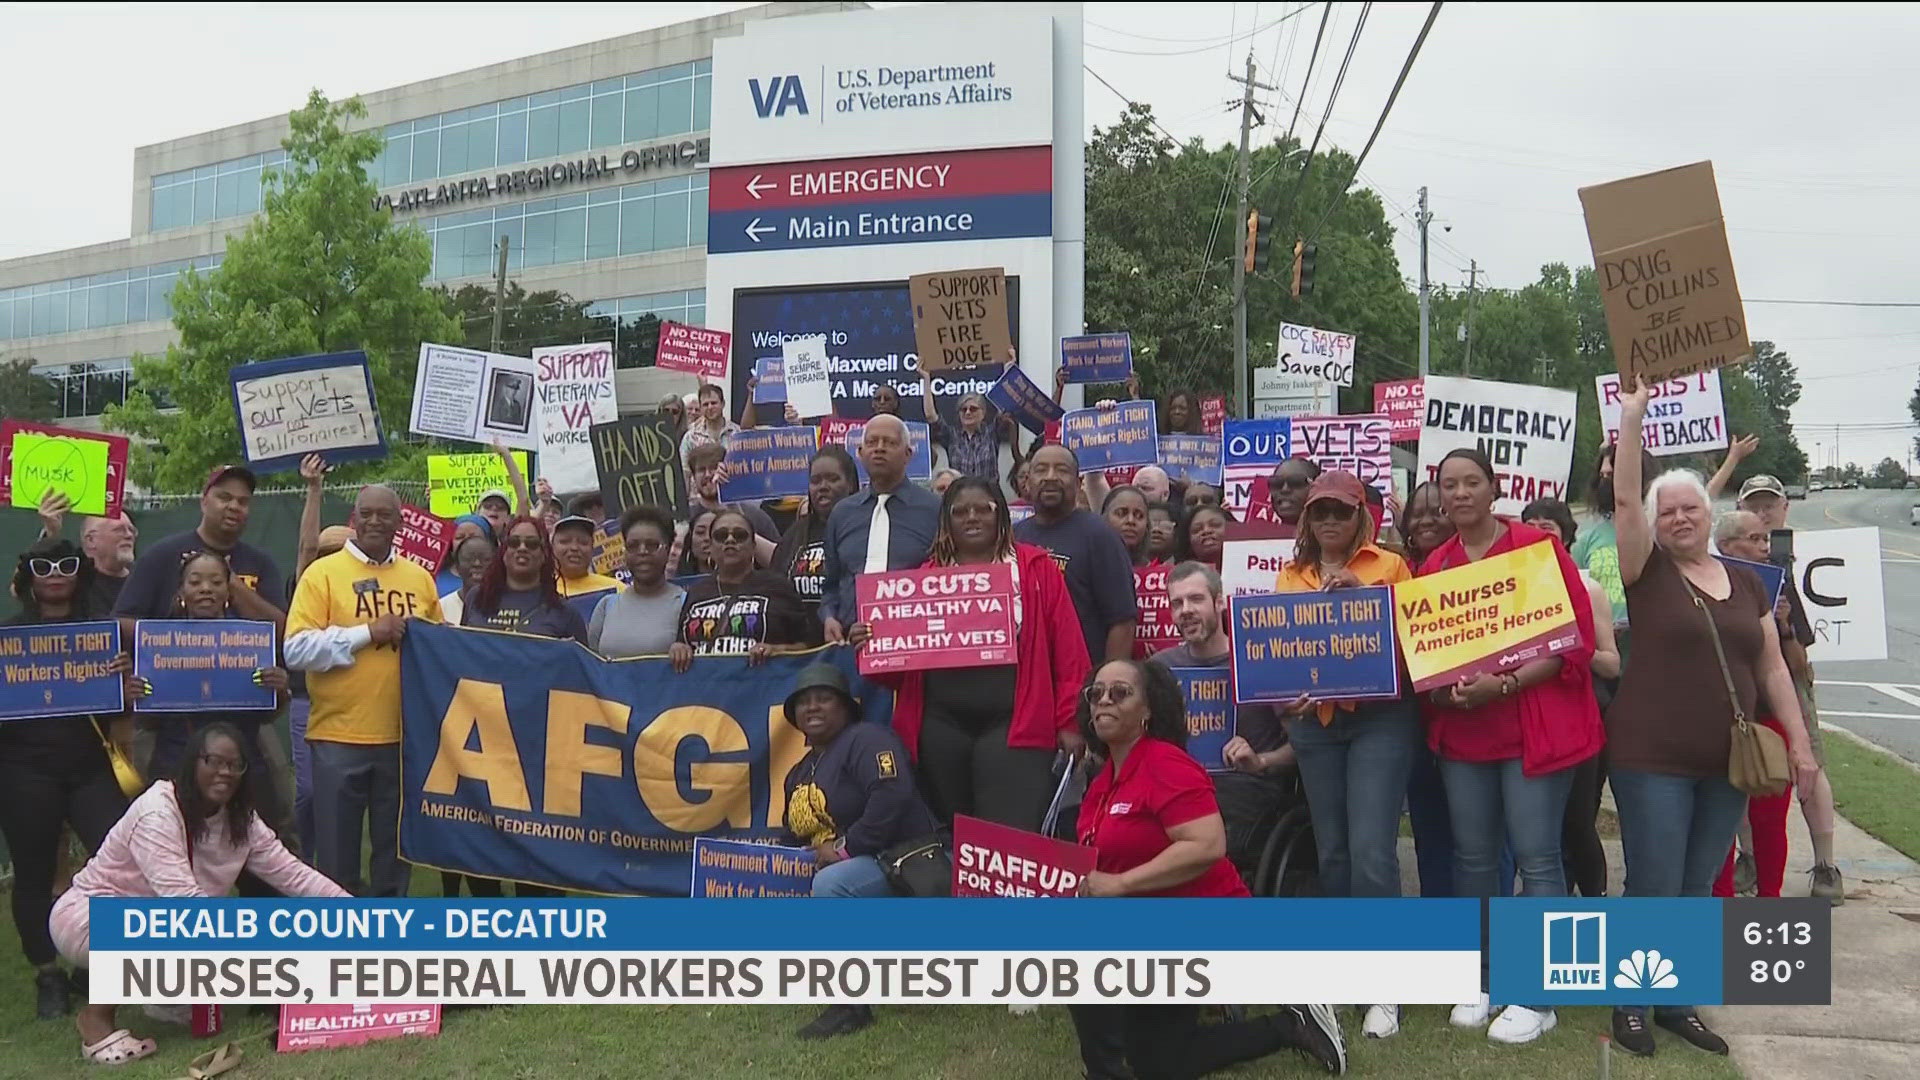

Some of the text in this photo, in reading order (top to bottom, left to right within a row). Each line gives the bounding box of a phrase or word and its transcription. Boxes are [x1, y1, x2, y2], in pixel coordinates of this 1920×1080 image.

[837, 61, 996, 90] U.S. Department
[747, 75, 810, 119] VA
[836, 83, 1013, 113] of Veterans Affairs
[400, 175, 492, 212] ATLANTA
[494, 154, 616, 195] REGIONAL
[619, 136, 710, 174] OFFICE
[789, 164, 951, 196] EMERGENCY
[788, 211, 974, 240] Main Entrance
[1603, 249, 1671, 293] DOUG
[928, 275, 1000, 299] SUPPORT
[1625, 267, 1720, 310] COLLINS
[940, 299, 987, 321] VETS
[1642, 305, 1686, 332] BE
[668, 327, 722, 344] NO CUTS
[832, 329, 848, 345] to
[937, 323, 983, 344] FIRE
[1281, 325, 1352, 350] CDC SAVES
[1629, 315, 1742, 373] ASHAMED
[663, 337, 724, 355] A HEALTHY VA
[942, 343, 993, 366] DOGE
[537, 350, 612, 382] SUPPORT
[661, 352, 723, 369] HEALTHY VETS
[825, 353, 898, 373] Maxwell
[1280, 353, 1353, 385] Save CDC
[241, 373, 330, 406] Support
[537, 381, 612, 404] VETERANS
[930, 377, 996, 396] Center
[1384, 385, 1409, 399] NO
[1602, 370, 1707, 406] RSIST
[251, 388, 355, 428] our Vets
[561, 401, 594, 431] VA
[1124, 407, 1150, 423] FIGHT
[1264, 403, 1312, 413] Department
[1380, 400, 1424, 412] A HEALT
[828, 421, 847, 434] NO
[1426, 398, 1572, 443] DEMOCRACY
[1607, 415, 1721, 450] PSH BACK!
[256, 413, 368, 457] Billionaires!
[543, 429, 590, 446] WORKE
[598, 420, 676, 473] HANDS
[1082, 430, 1117, 449] Workers
[1118, 426, 1150, 444] Rights!
[1229, 422, 1382, 460] OUR VETS
[448, 455, 504, 468] SUPPORT
[1476, 437, 1528, 466] NOT
[25, 466, 75, 483] MUSK
[466, 467, 487, 477] OUR
[751, 458, 765, 474] for
[446, 475, 504, 489] VETERANS
[617, 462, 678, 513] OFF!
[427, 537, 441, 553] VA
[1247, 555, 1283, 572] Pati
[875, 572, 992, 600] NO CUTS
[691, 600, 760, 619] STROGER
[869, 598, 1003, 621] A HEALTHY VA
[1400, 576, 1518, 621] VA Nurses
[1241, 599, 1382, 630] STAND, UNITE, FIGHT
[1409, 603, 1500, 638] Protecting
[141, 630, 271, 648] Proud Veteran, Dedicated
[1414, 621, 1500, 655] America's
[1503, 602, 1564, 632] Heroes
[30, 631, 112, 655] UNITE, FIGHT
[868, 629, 1007, 653] HEALTHY VETS
[1245, 631, 1382, 661] for Workers Rights!
[5, 659, 111, 683] Workers Rights!
[153, 652, 259, 670] Government Worker!
[1190, 680, 1229, 701] FIGHT
[1184, 710, 1226, 737] ights!
[420, 799, 694, 853] AMERICAN FEDERATION OF GOVERNME
[699, 845, 815, 878] Government Worker
[959, 842, 1039, 883] STAFF
[705, 878, 756, 898] Work for
[957, 869, 991, 893] FOR
[290, 1009, 431, 1032] HEALTHY VETS
